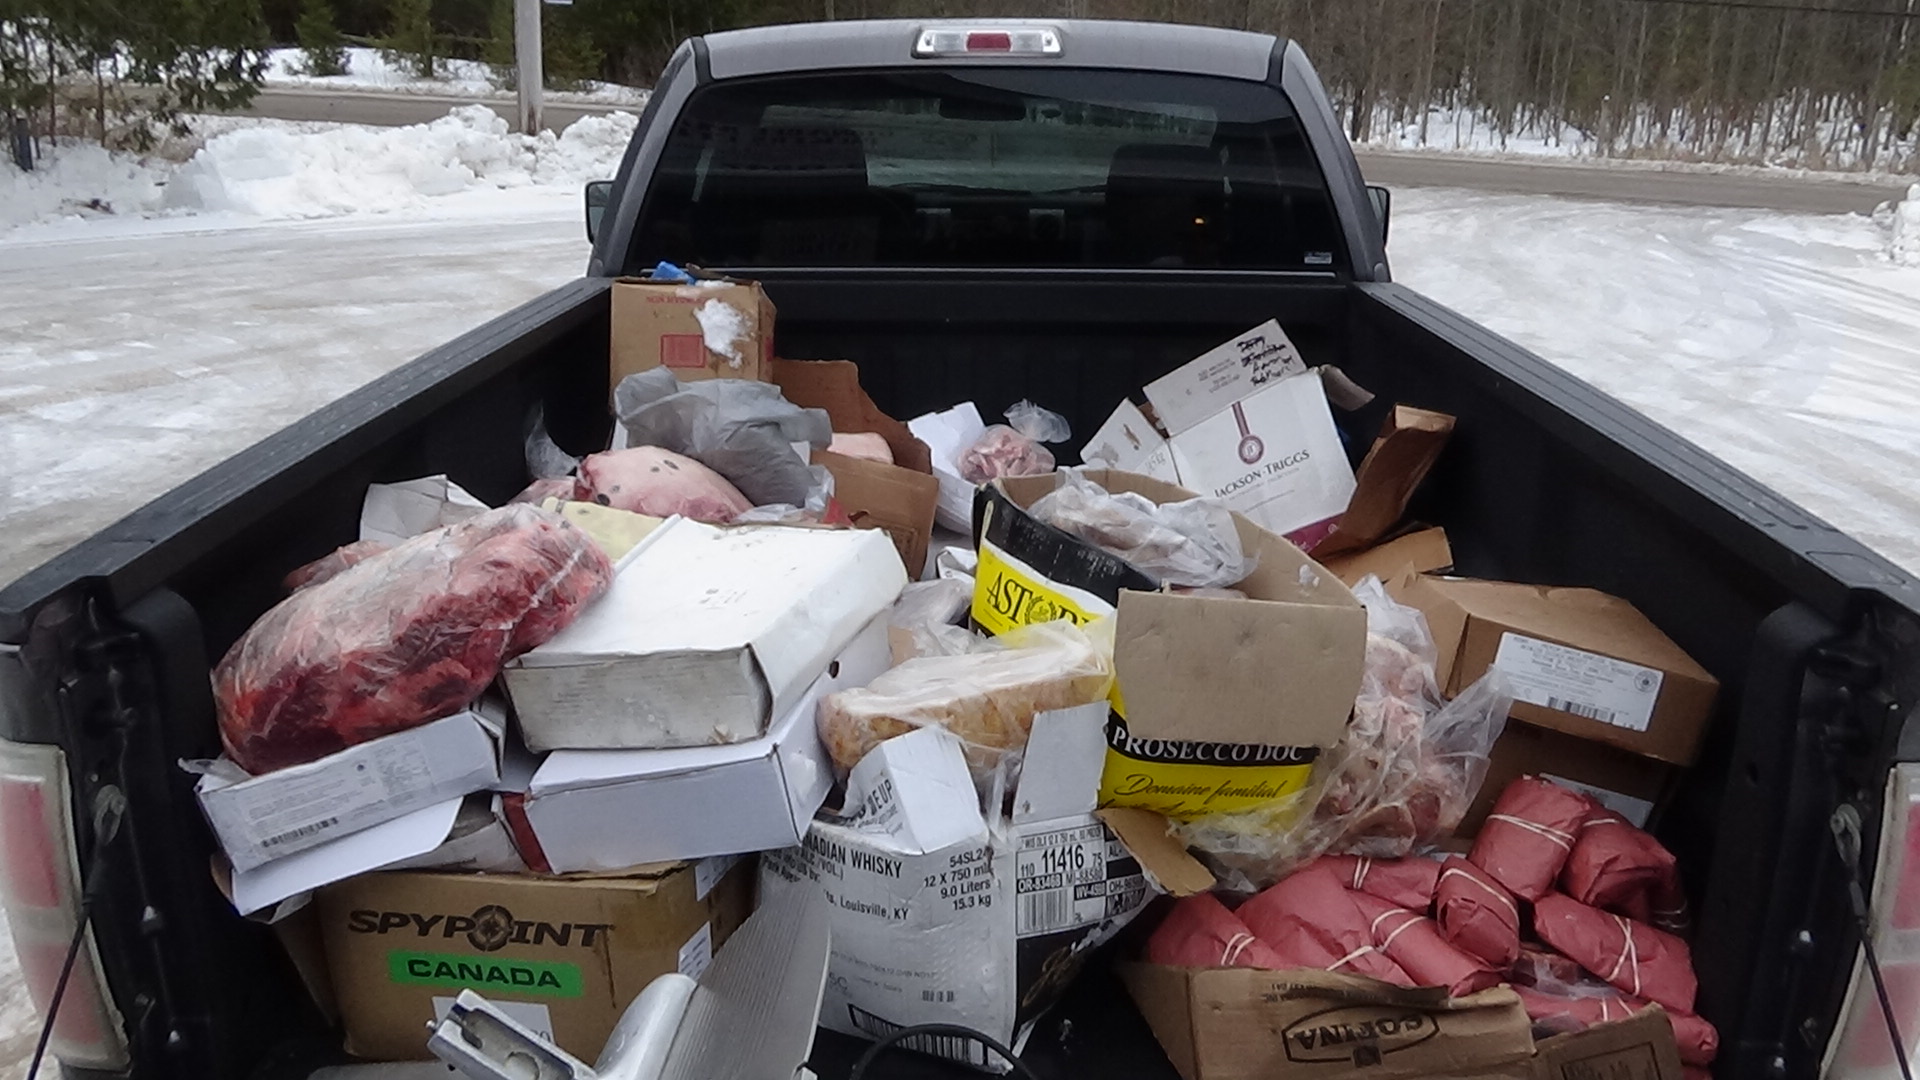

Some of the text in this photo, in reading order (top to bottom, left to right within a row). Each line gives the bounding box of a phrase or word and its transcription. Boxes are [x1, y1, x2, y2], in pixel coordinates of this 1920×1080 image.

[1214, 449, 1310, 498] JACKSON-TRIGGS
[986, 571, 1090, 625] ASTO
[1112, 725, 1303, 761] PROSECCO DOC
[1114, 774, 1288, 805] Domaine familial
[803, 831, 846, 865] NADIAN
[850, 849, 903, 879] WHISKY
[1020, 862, 1035, 877] 110
[1041, 844, 1084, 873] 11416
[924, 875, 936, 888] 12
[939, 872, 948, 885] X
[951, 867, 971, 882] 750
[940, 879, 991, 899] 9.0 Liters
[840, 896, 890, 919] Louisville,
[894, 908, 909, 920] KY
[953, 894, 992, 911] 15.3 kg
[348, 905, 612, 952] SPYPOINT
[407, 959, 562, 988] CANADA
